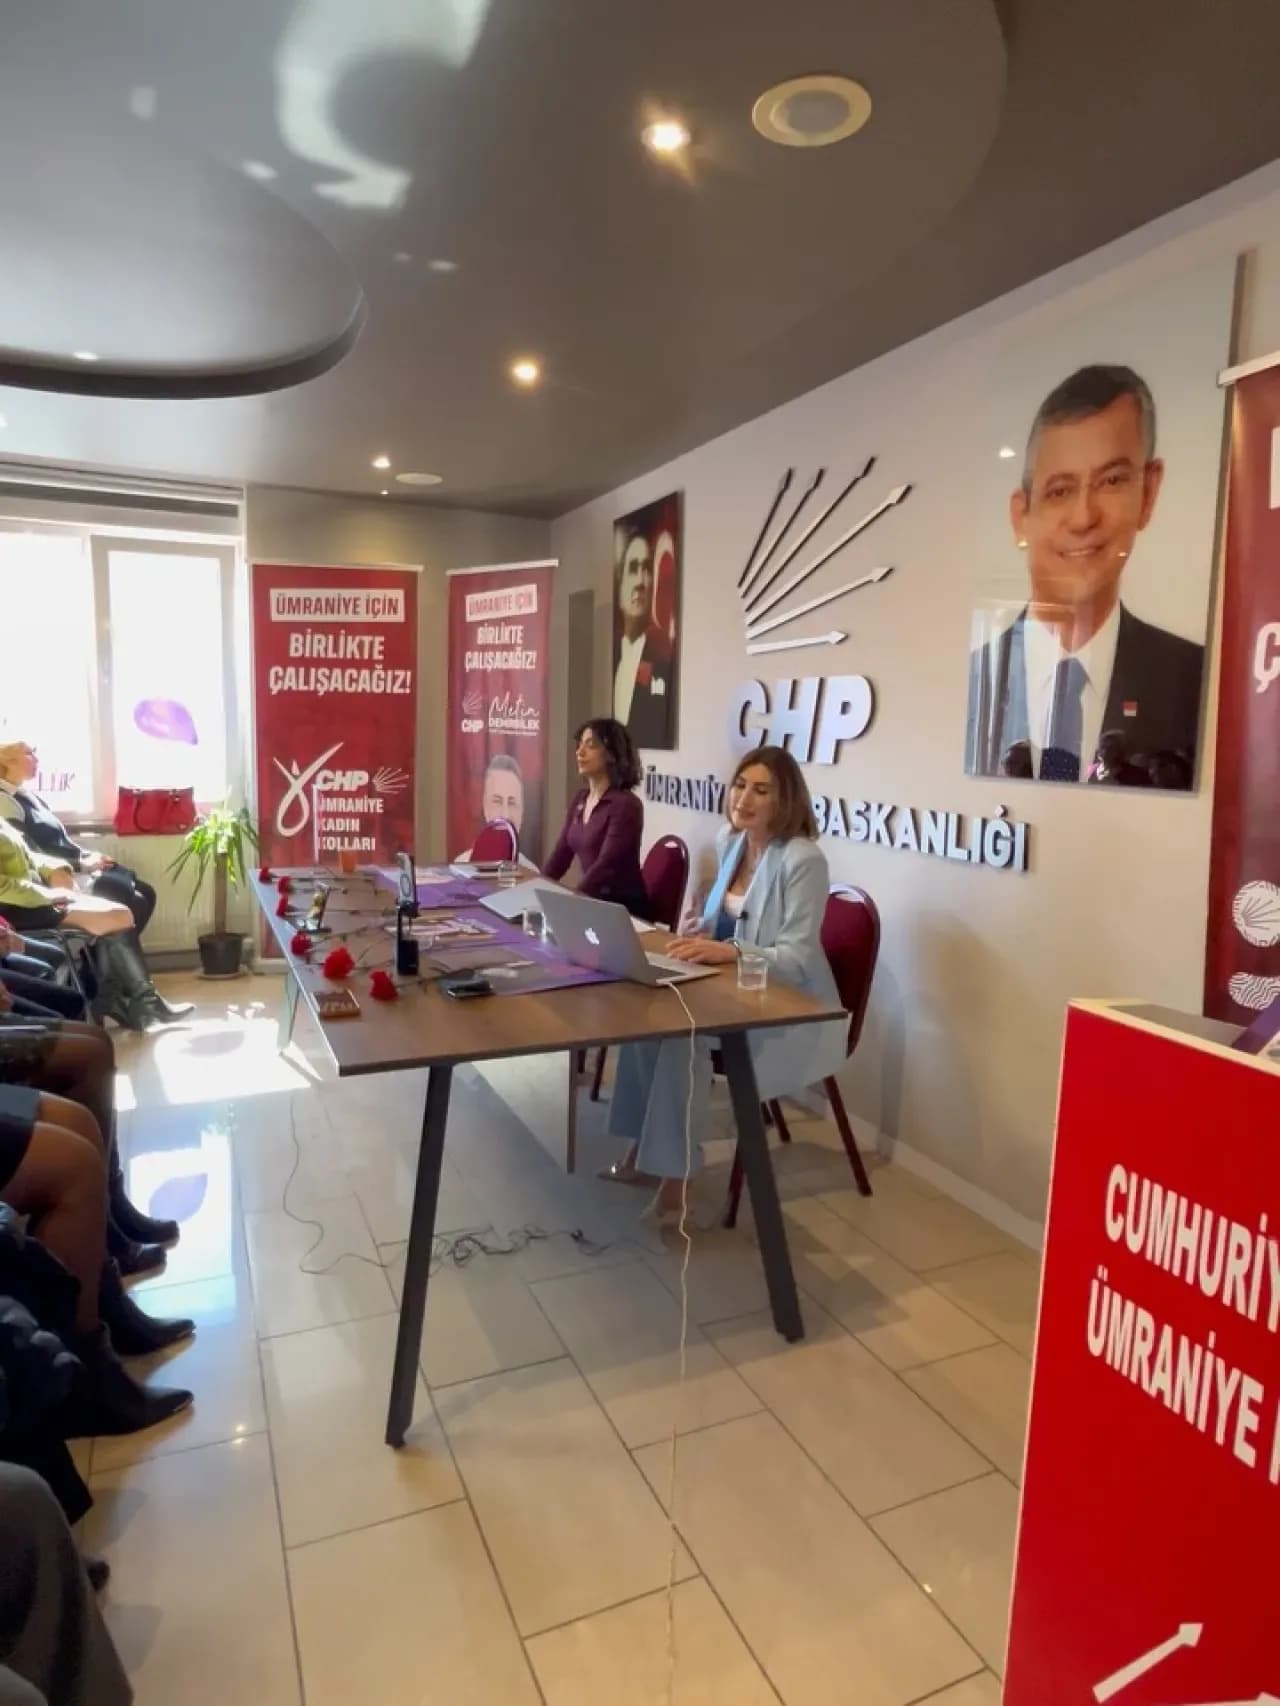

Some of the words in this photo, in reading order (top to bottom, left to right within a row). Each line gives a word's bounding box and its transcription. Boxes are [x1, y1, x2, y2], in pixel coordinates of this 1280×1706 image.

[276, 592, 361, 616] ÜMRANİYE
[365, 593, 400, 618] İÇİN
[289, 628, 385, 660] BİRLİKTE
[477, 621, 524, 645] BİRLİKTE
[269, 664, 412, 696] ÇALIŞACAĞIZ!
[728, 675, 875, 765] CHP
[316, 769, 369, 791] CHP
[646, 765, 726, 815] ÜMRANİY
[1105, 1163, 1280, 1334] CUMHURİY
[1087, 1264, 1265, 1469] ÜMRANİYE
